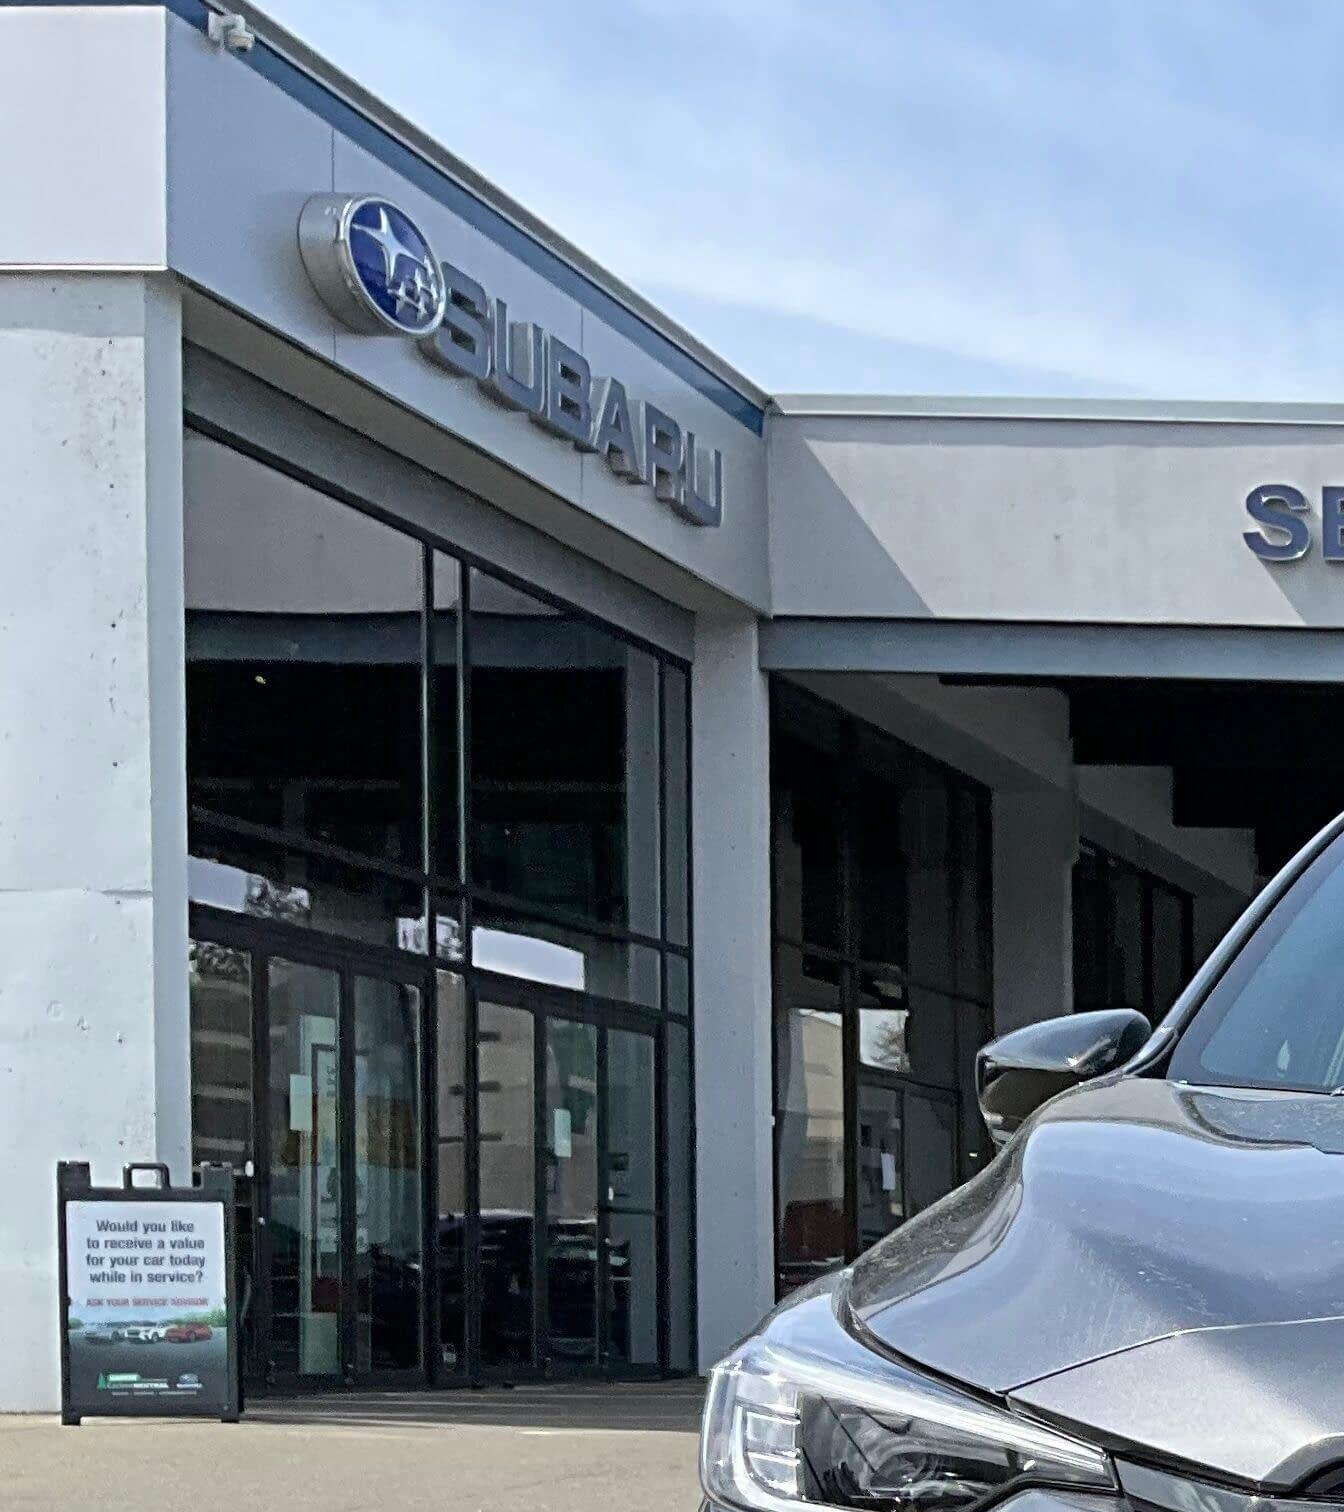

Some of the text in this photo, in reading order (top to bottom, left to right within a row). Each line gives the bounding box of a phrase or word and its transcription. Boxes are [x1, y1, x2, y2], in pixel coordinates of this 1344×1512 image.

[438, 260, 723, 527] SUBARU
[96, 1219, 194, 1235] Would you like
[86, 1236, 205, 1249] to receive a value
[86, 1253, 205, 1269] for your car today
[89, 1270, 204, 1283] while in service?
